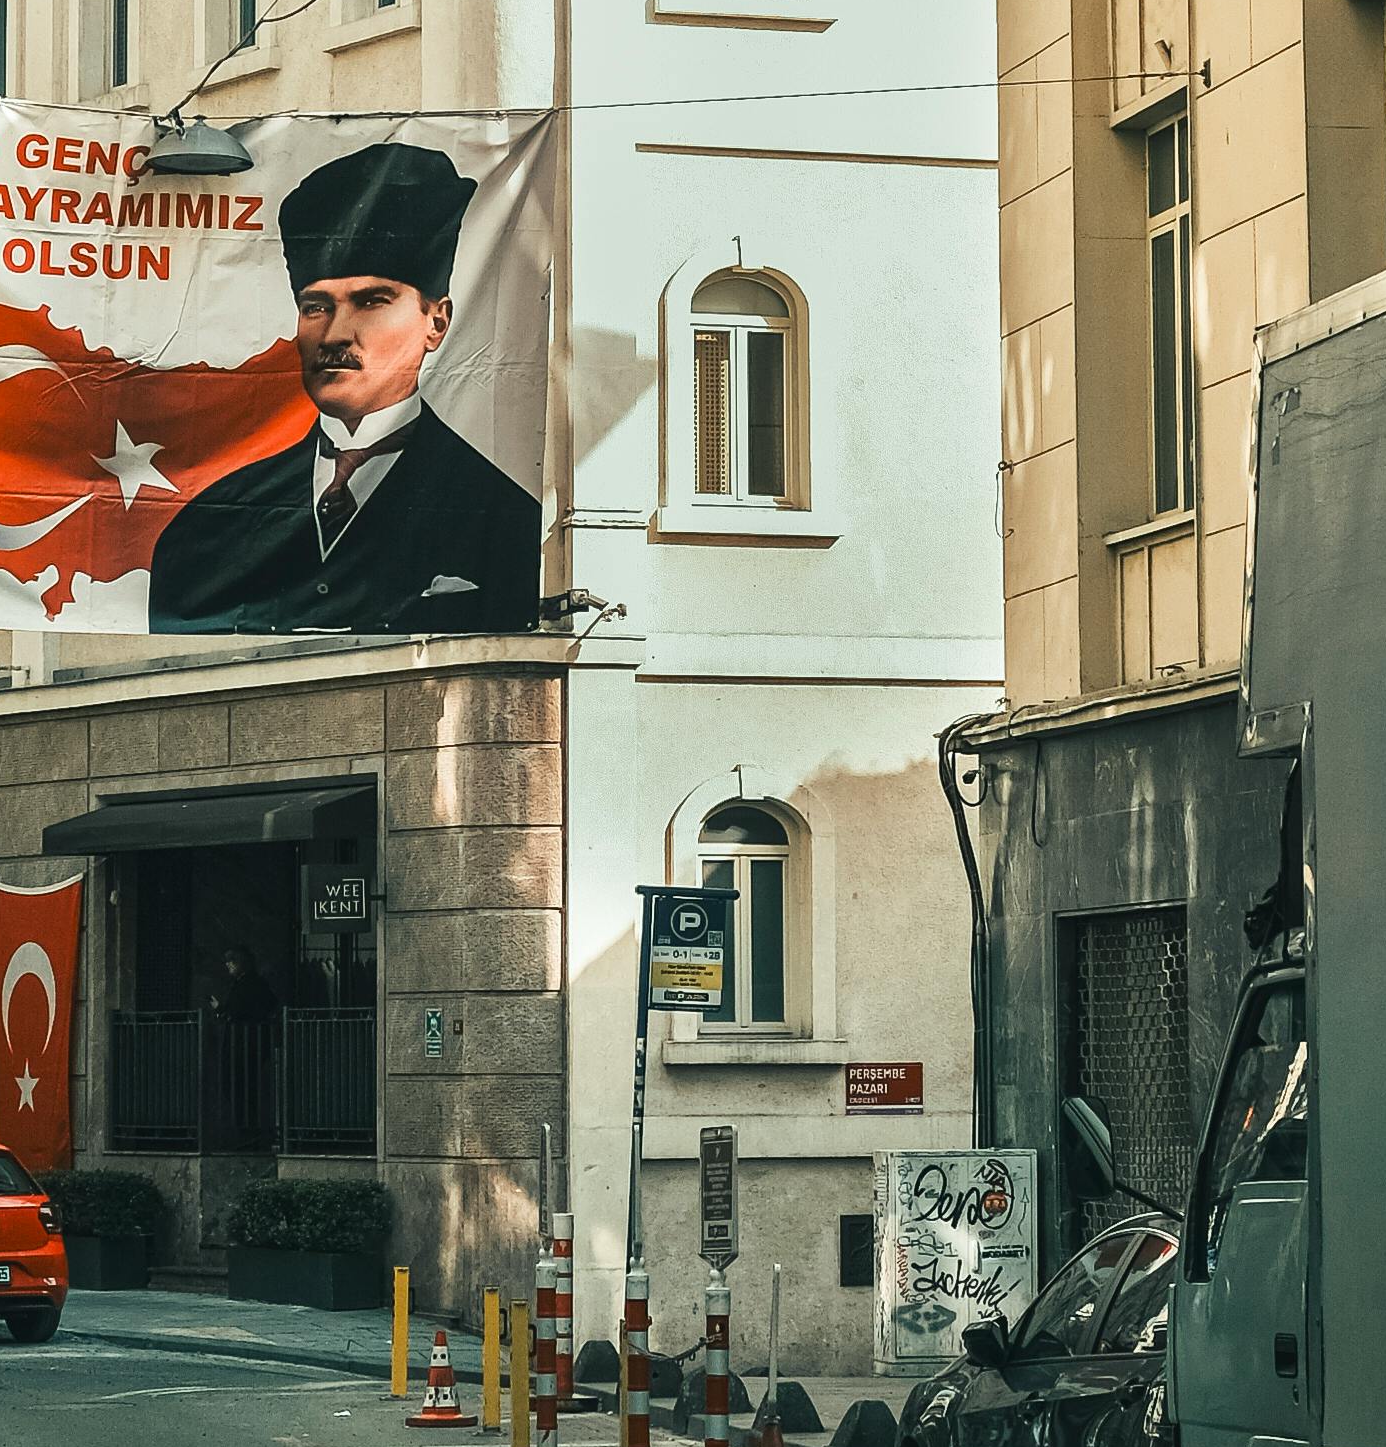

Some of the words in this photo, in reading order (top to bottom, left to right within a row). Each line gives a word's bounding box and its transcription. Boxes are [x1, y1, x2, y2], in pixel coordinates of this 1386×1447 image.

[15, 132, 154, 187] GENÇ
[2, 236, 171, 281] OLSUN
[326, 883, 360, 898] WEE
[319, 900, 360, 914] KENT
[679, 912, 701, 932] P
[849, 1068, 907, 1081] PERŞEMBE
[849, 1083, 888, 1095] PAZARI
